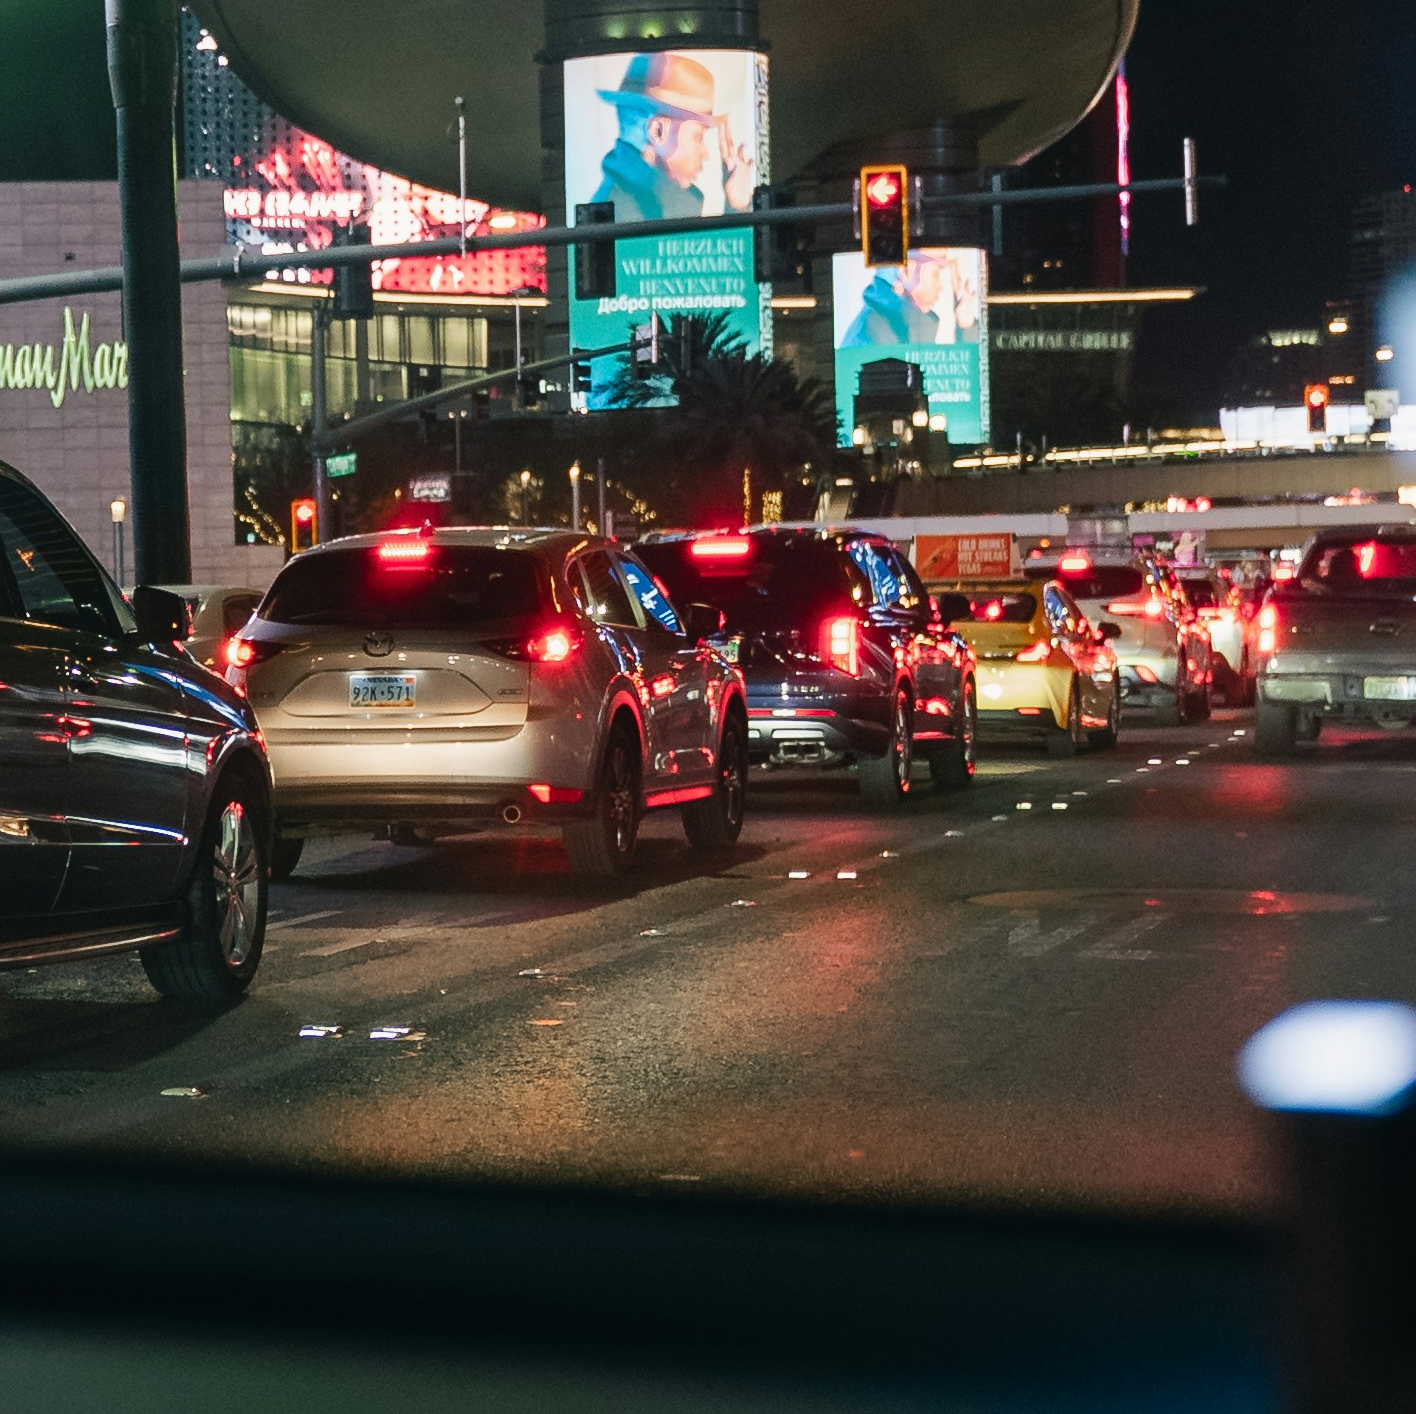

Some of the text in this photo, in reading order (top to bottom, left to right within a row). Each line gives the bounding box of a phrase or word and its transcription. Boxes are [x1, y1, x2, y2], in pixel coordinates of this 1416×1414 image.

[658, 239, 744, 256] HERZLICH
[621, 257, 746, 275] WILLKOMMEN
[639, 277, 745, 295] BENVENUTO
[597, 295, 746, 314] Добро пожаловать
[51, 306, 129, 408] Mar
